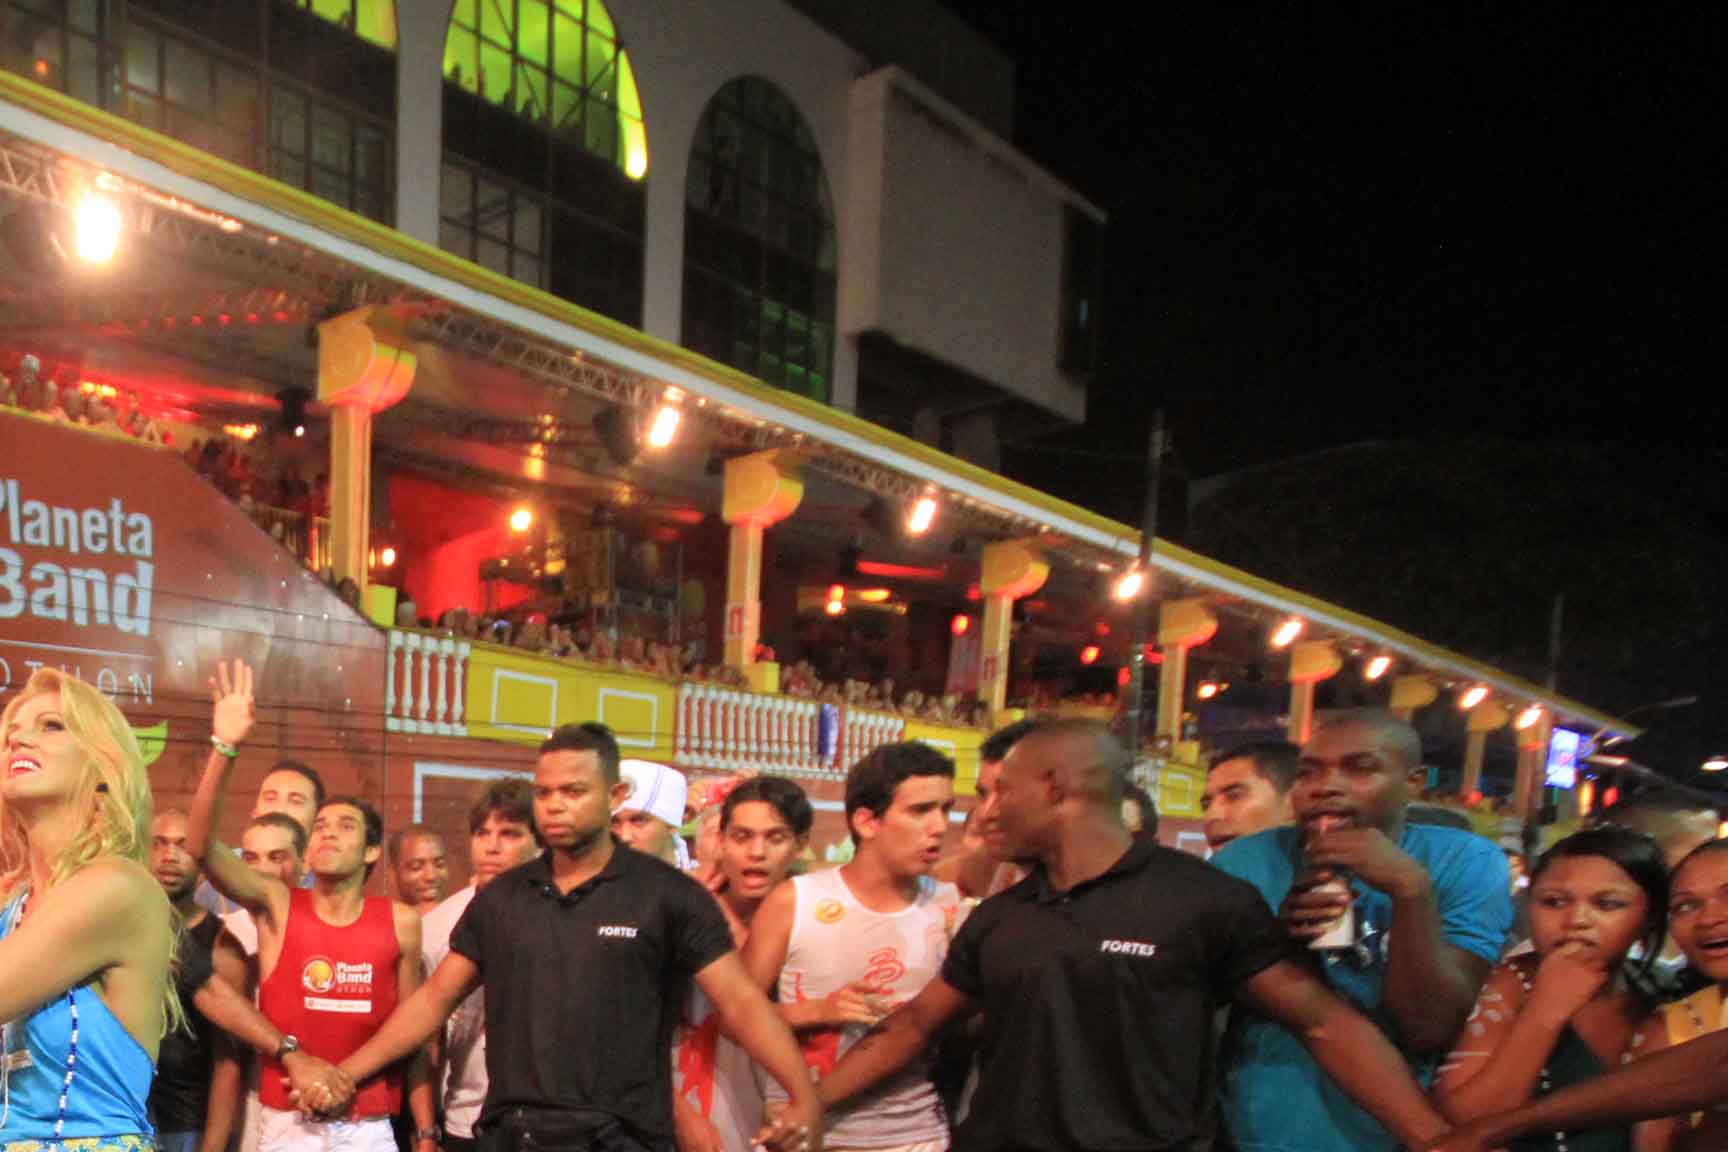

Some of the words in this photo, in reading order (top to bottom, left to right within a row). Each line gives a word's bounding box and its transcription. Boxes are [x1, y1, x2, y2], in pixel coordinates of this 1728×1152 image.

[598, 926, 638, 938] FORTES
[1101, 940, 1156, 956] FORTES
[336, 973, 373, 984] Band
